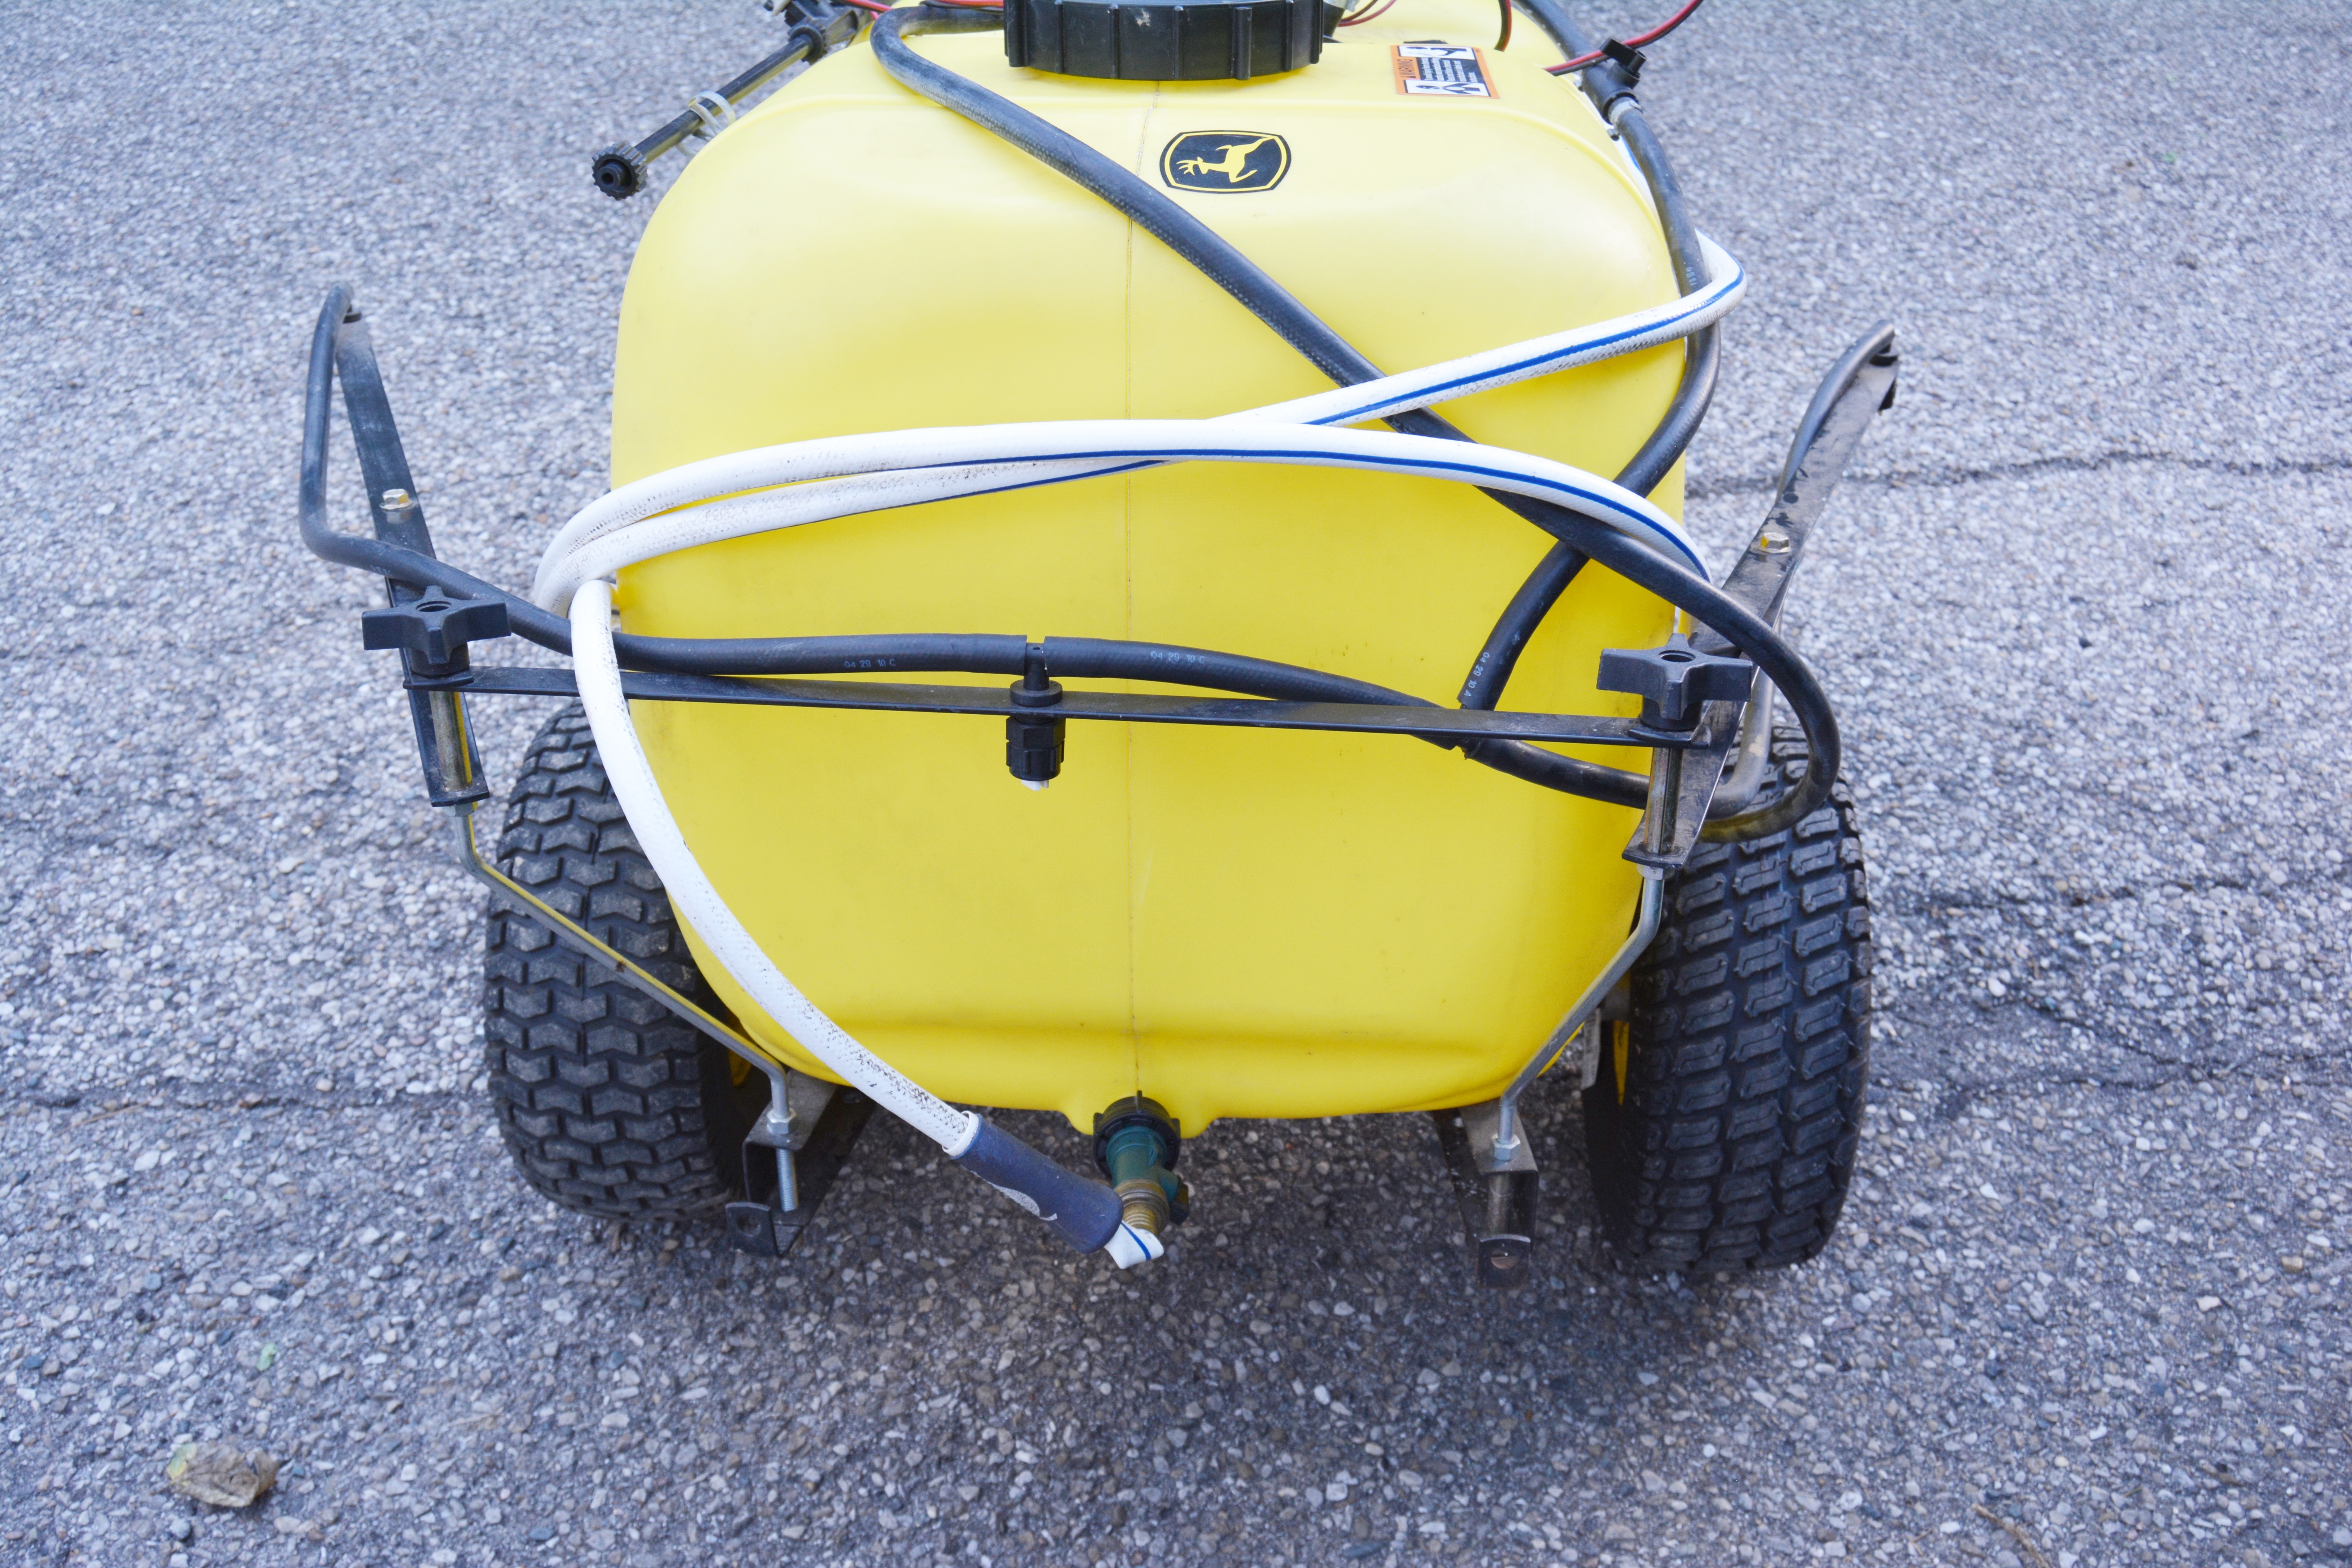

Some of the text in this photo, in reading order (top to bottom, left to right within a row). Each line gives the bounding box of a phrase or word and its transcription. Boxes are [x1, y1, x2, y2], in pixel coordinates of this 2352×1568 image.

[1151, 651, 1163, 660] 04
[1167, 652, 1180, 662] 29
[1185, 654, 1195, 663] 10
[859, 659, 871, 668] 29
[1473, 664, 1484, 676] 29
